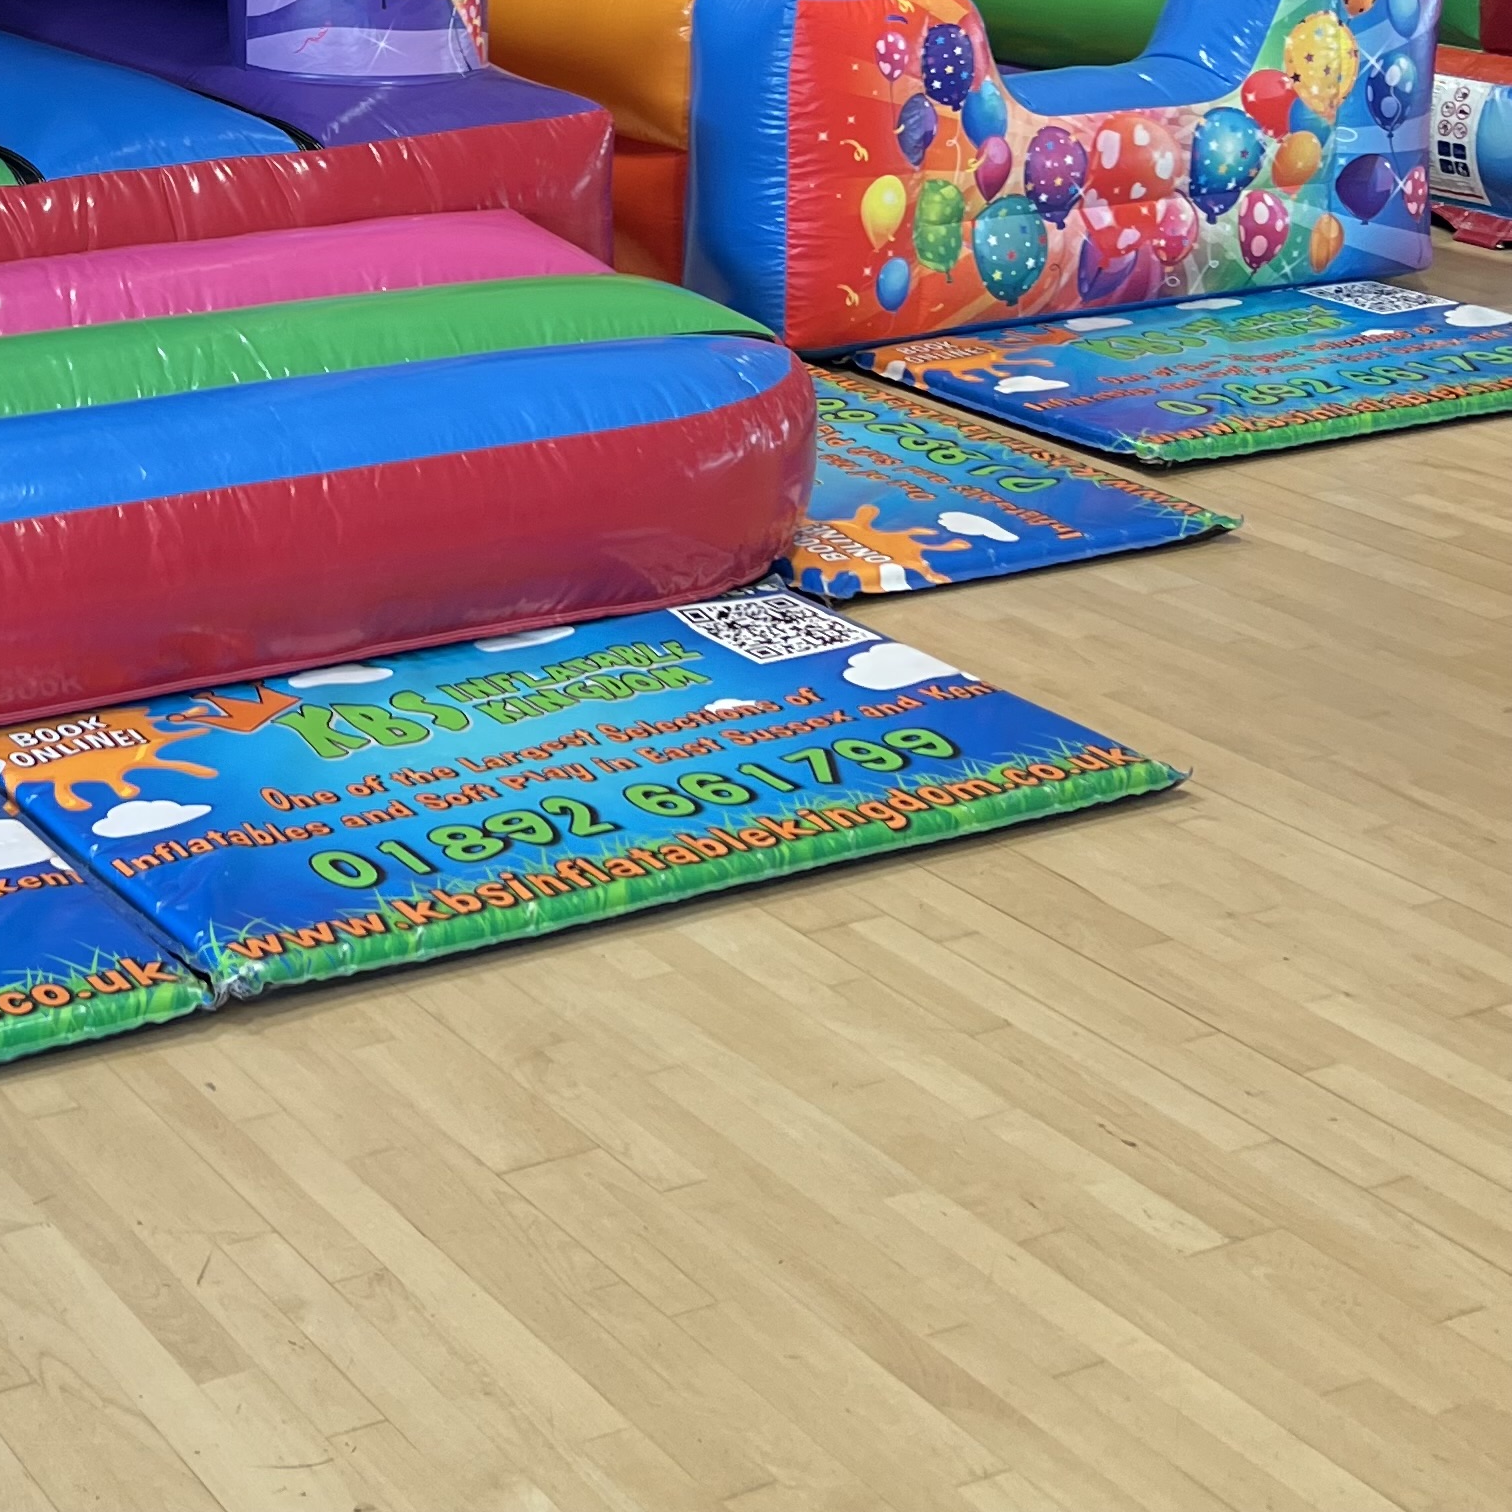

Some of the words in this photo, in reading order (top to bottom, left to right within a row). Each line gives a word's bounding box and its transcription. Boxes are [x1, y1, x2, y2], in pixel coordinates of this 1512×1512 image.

[895, 338, 958, 356] BOOK
[1071, 330, 1208, 361] KBS
[1155, 377, 1352, 418] 01892
[864, 422, 1060, 495] 01892
[436, 638, 705, 702] INFLATABLE
[473, 665, 713, 725] KINGDOM
[7, 714, 111, 749] BOOK
[7, 728, 151, 769] ONLINE!
[259, 786, 341, 812] One
[345, 774, 390, 798] of
[390, 766, 460, 788] the
[455, 727, 600, 774] Largest
[595, 700, 784, 744] Selections
[783, 685, 827, 707] of
[270, 690, 471, 760] KBS
[109, 821, 336, 879] Inflatables
[339, 800, 419, 828] and
[413, 782, 505, 811] Soft
[497, 762, 598, 790] Play
[590, 755, 643, 775] in
[632, 736, 728, 765] East
[718, 707, 856, 748] Sussex
[856, 694, 926, 721] and
[308, 795, 624, 889] 01892
[622, 727, 961, 818] 661799
[226, 743, 1148, 961] www.kbsinflatablekingdom.co.uk
